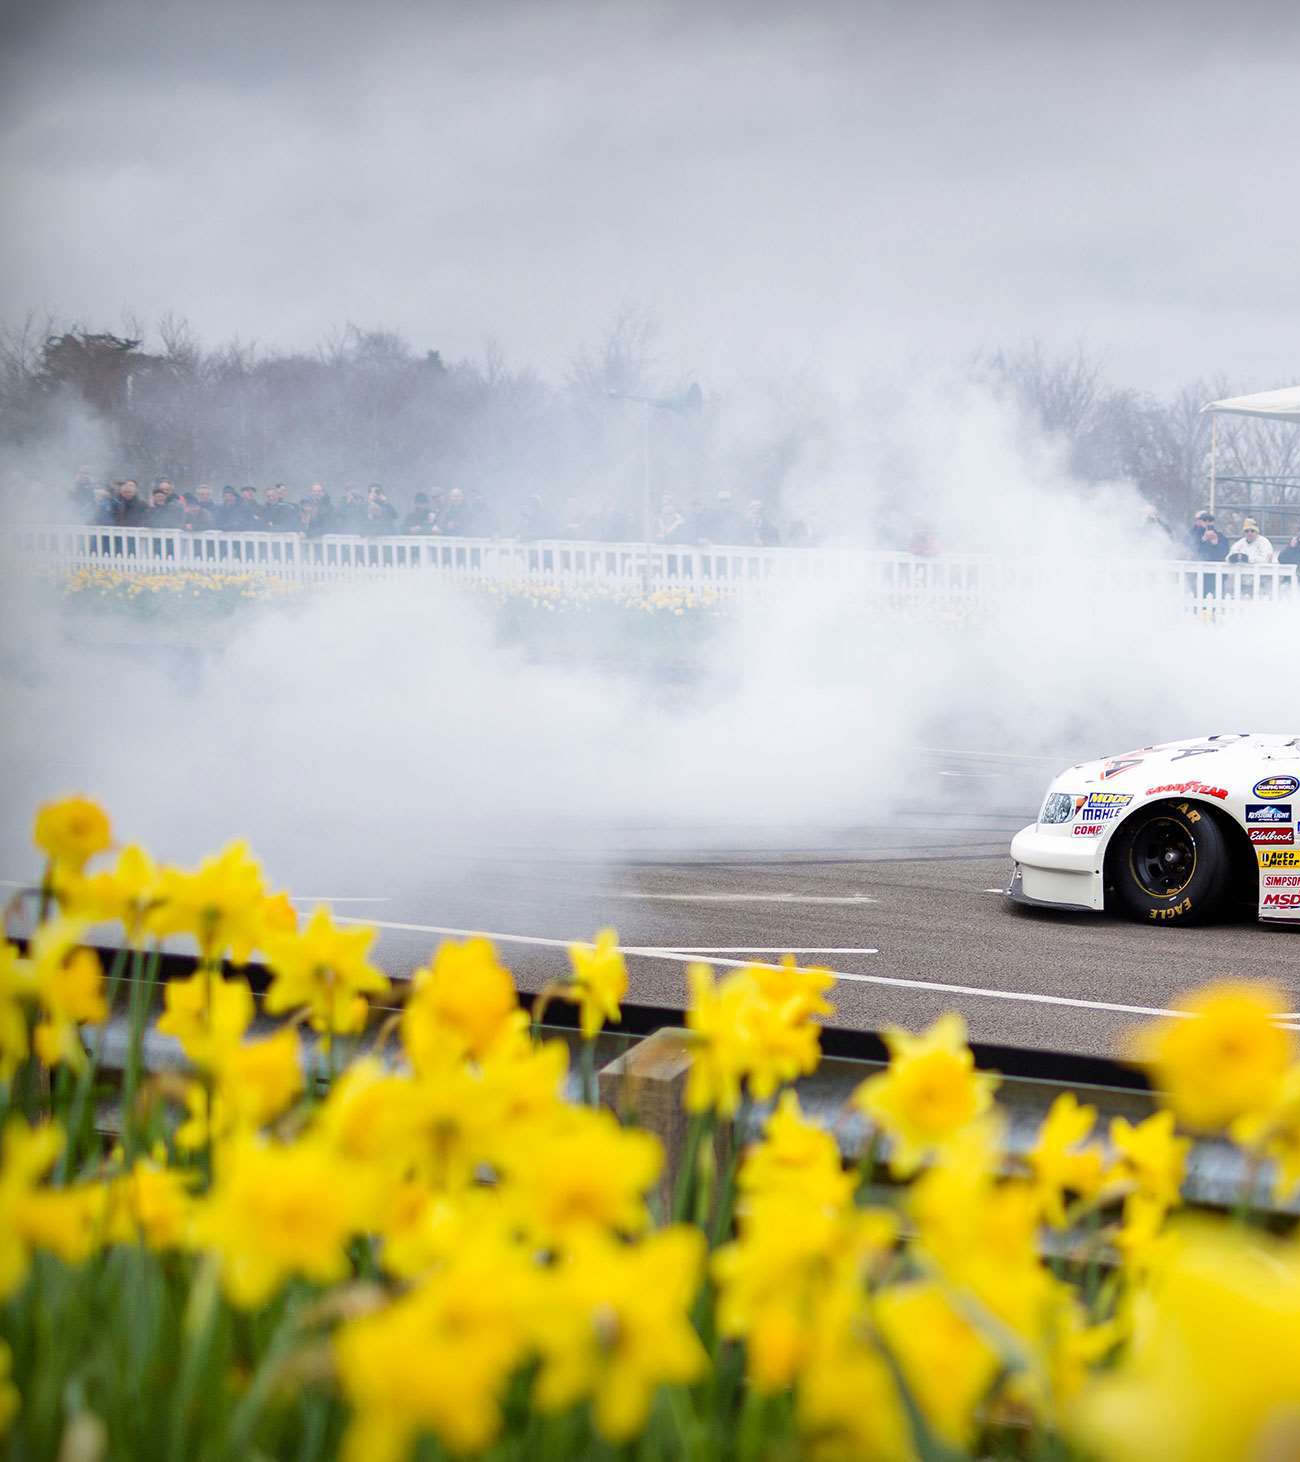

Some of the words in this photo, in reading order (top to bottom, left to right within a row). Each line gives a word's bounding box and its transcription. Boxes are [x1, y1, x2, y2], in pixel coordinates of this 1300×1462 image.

[1146, 781, 1229, 800] GOODYEAR
[1090, 793, 1129, 803] MOOG
[1082, 808, 1122, 820] MAHLE
[1250, 830, 1293, 841] Edelbrock
[1149, 897, 1193, 919] EAGLE
